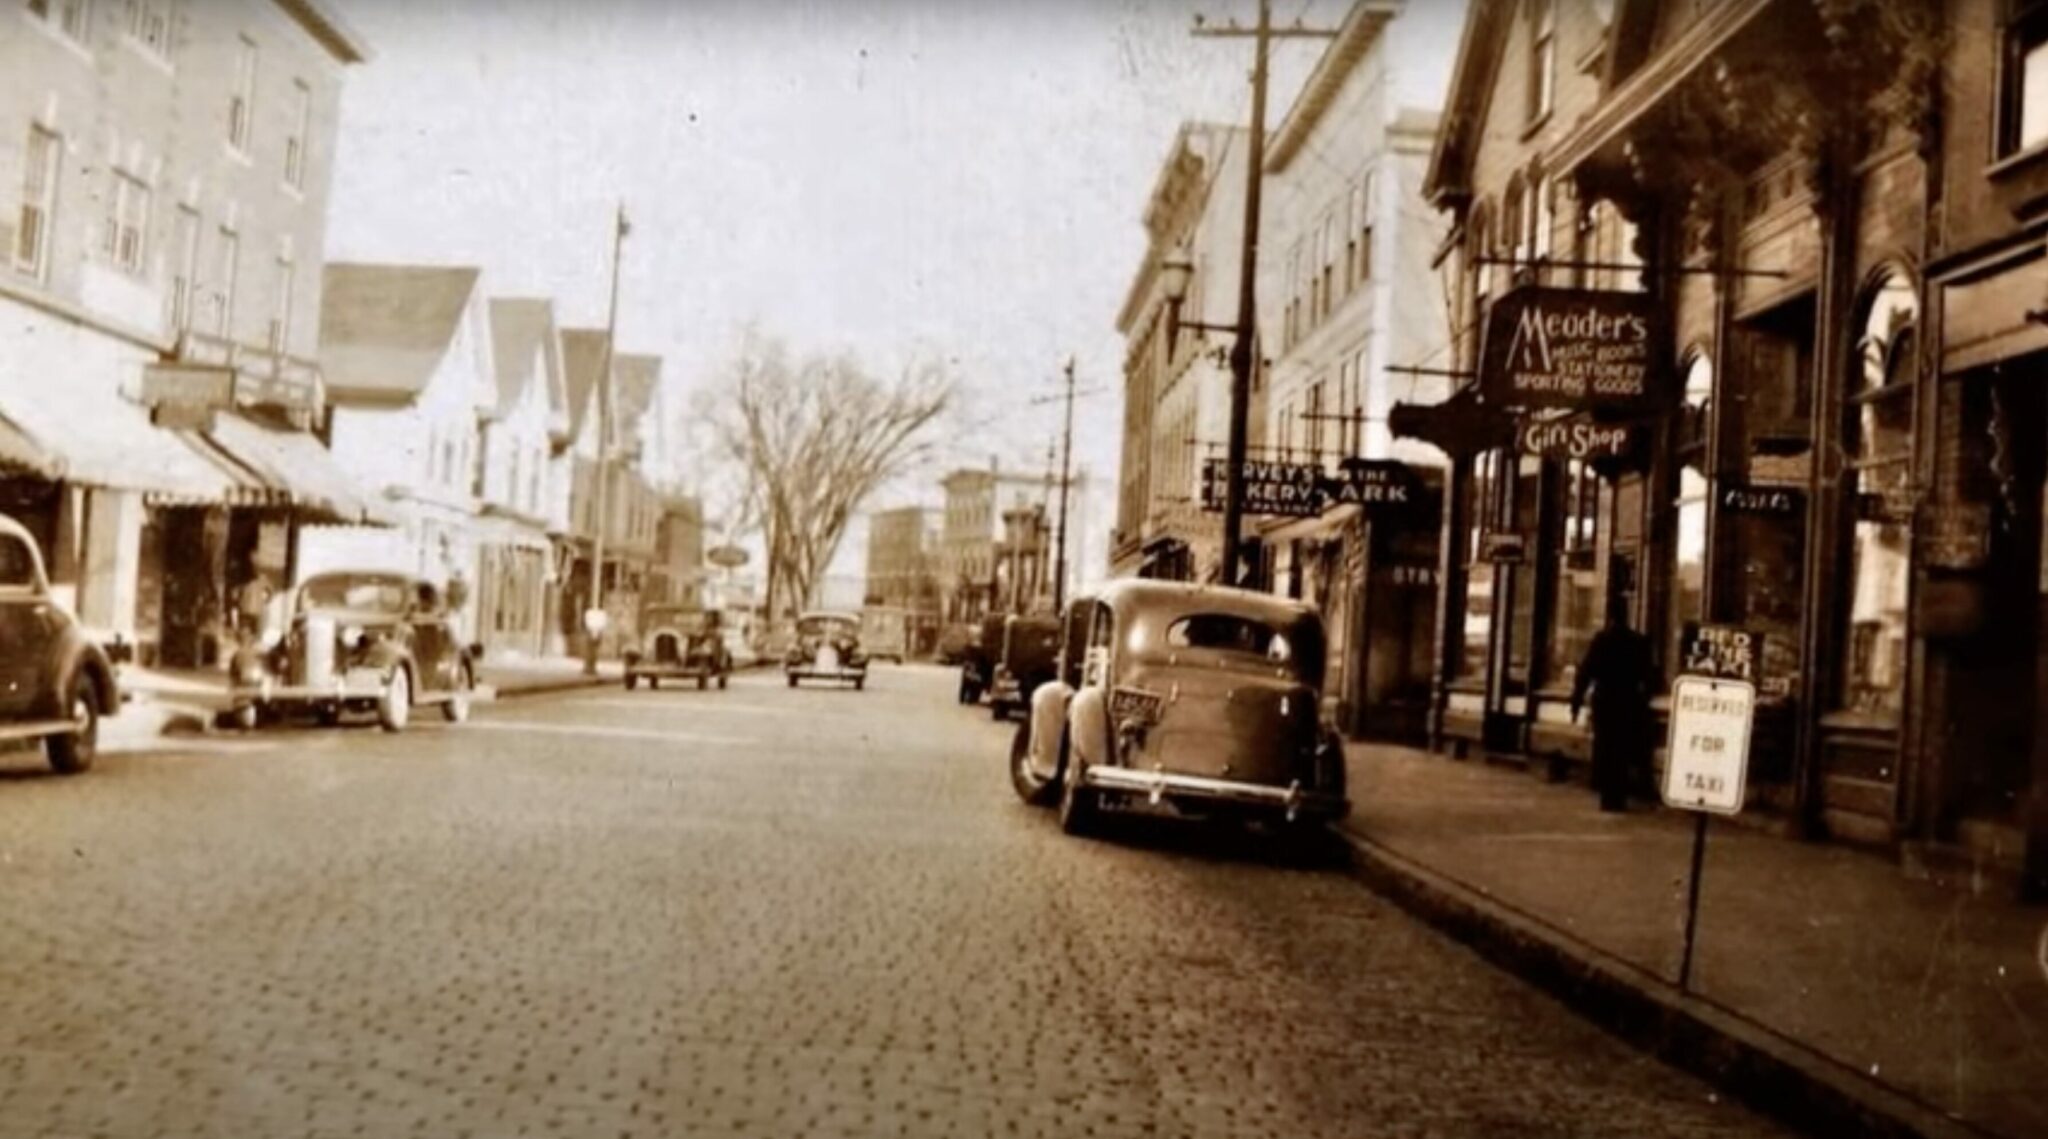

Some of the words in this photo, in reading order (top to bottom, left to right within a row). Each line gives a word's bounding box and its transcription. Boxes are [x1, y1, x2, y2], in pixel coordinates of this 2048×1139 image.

[1504, 306, 1648, 371] Meader's
[1569, 423, 1627, 457] Shop
[1211, 481, 1313, 502] BKERY
[1690, 733, 1726, 753] FOR
[1685, 772, 1725, 794] TAXI
